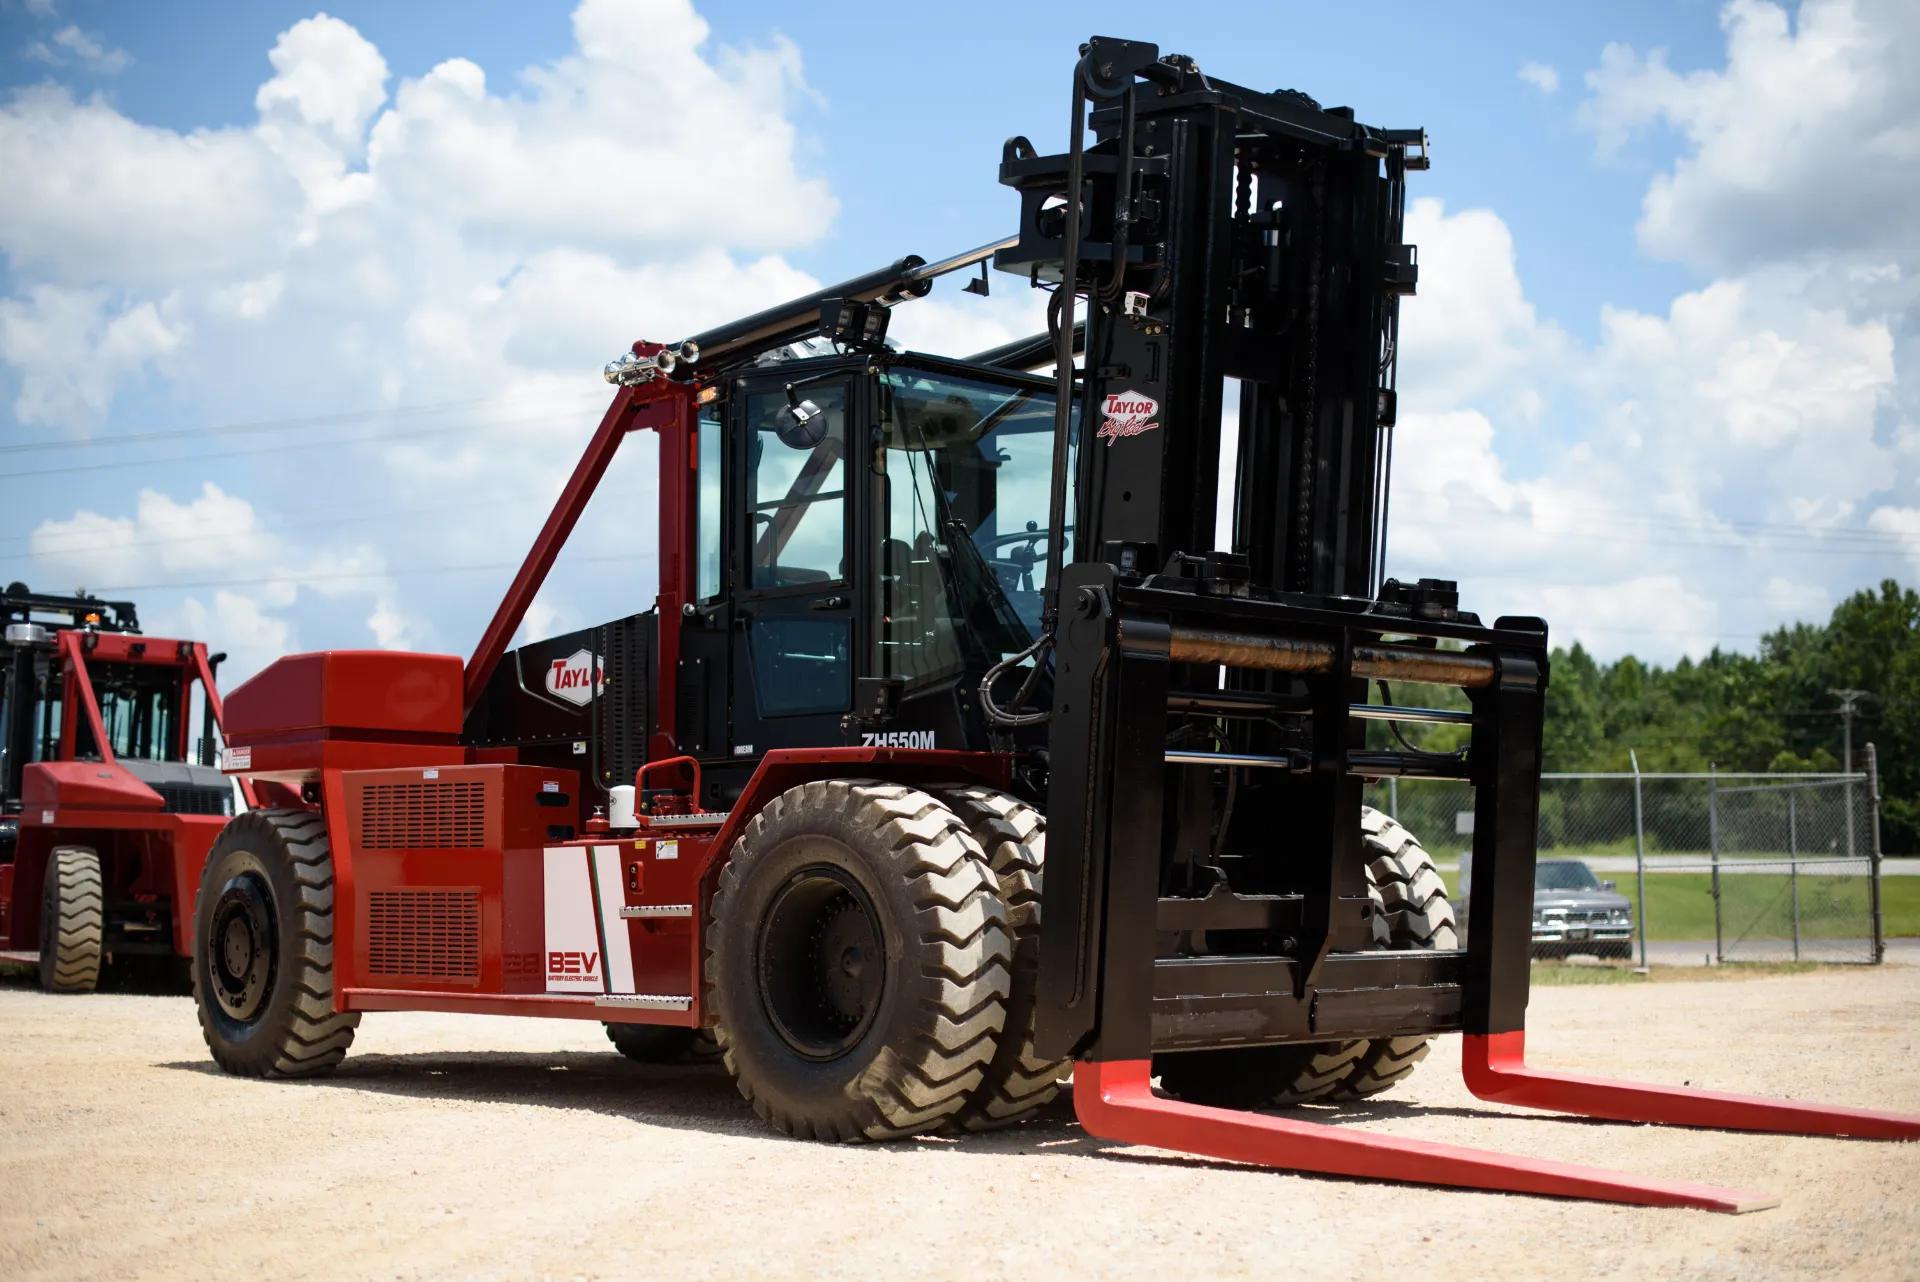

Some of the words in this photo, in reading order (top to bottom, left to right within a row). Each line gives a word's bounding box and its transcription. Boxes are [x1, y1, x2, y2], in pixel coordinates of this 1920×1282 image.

[1107, 396, 1153, 414] TAYLOR
[861, 730, 935, 750] ZH550M
[548, 951, 598, 974] BEV
